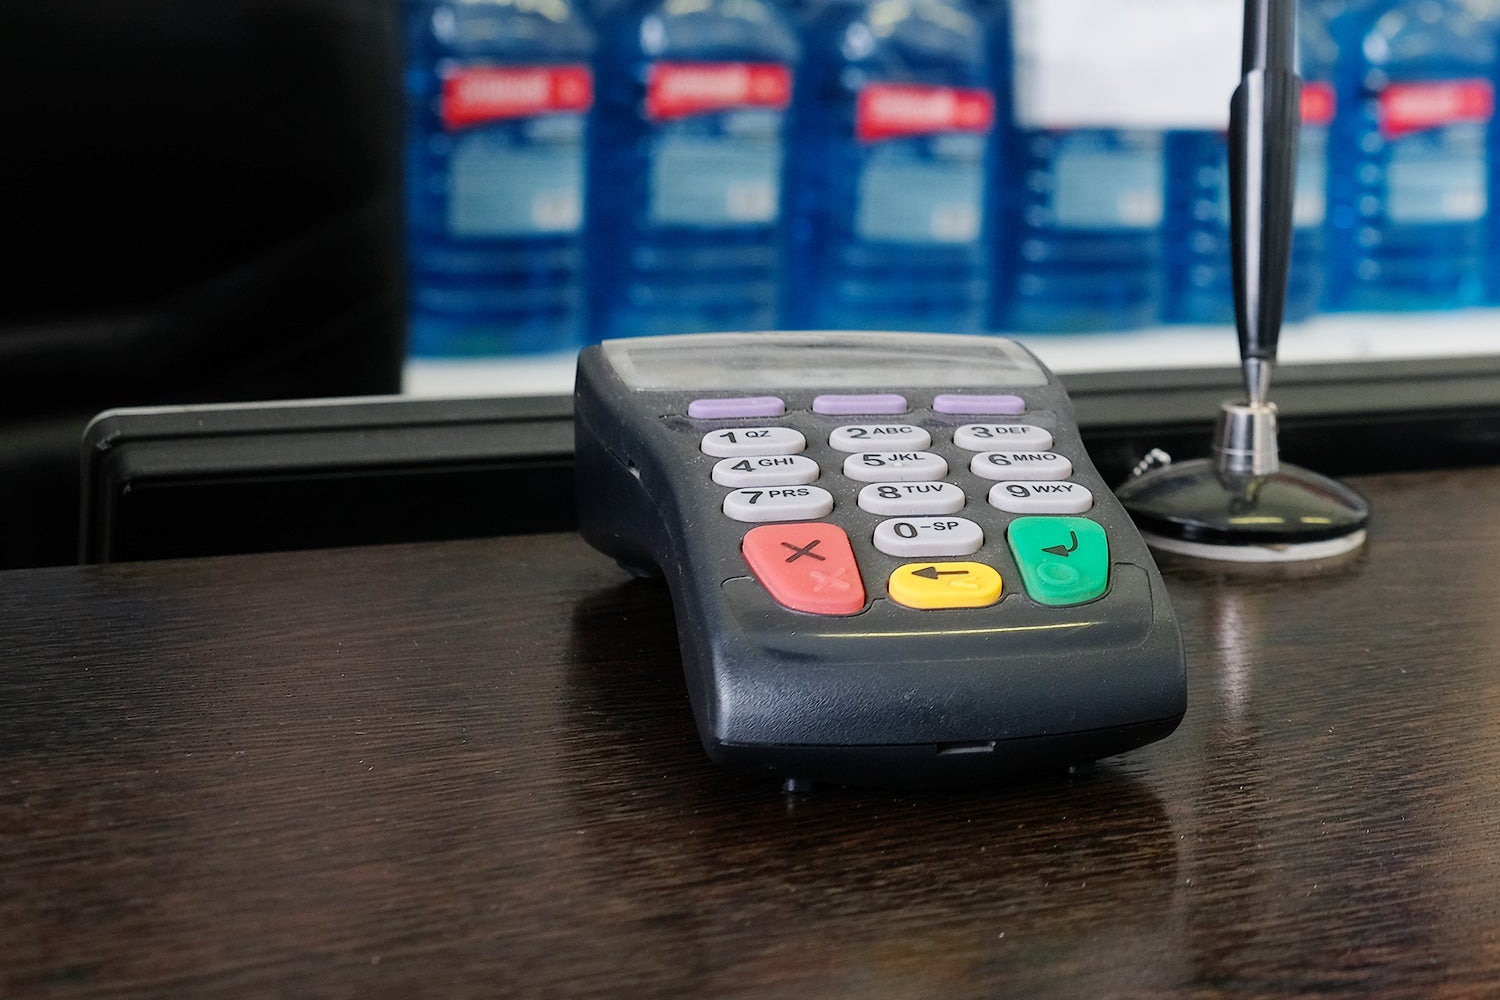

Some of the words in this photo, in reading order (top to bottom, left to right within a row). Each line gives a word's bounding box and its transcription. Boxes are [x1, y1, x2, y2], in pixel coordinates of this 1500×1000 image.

[719, 431, 737, 444] 1
[745, 430, 771, 438] QZ
[846, 427, 871, 439] 2
[873, 426, 913, 435] ABC
[971, 426, 994, 439] 3
[995, 426, 1031, 435] DEF
[730, 459, 756, 472] 4
[758, 457, 794, 467] GHI
[862, 453, 886, 467] 5
[887, 453, 926, 462] JKL
[988, 453, 1012, 466] 6
[1013, 453, 1057, 461] MNO
[740, 490, 764, 504] 7
[768, 487, 810, 499] PRS
[877, 485, 902, 499] 8
[902, 484, 944, 493] TUV
[1006, 484, 1031, 498] 9
[1031, 484, 1073, 494] WXY
[893, 522, 918, 539] 0
